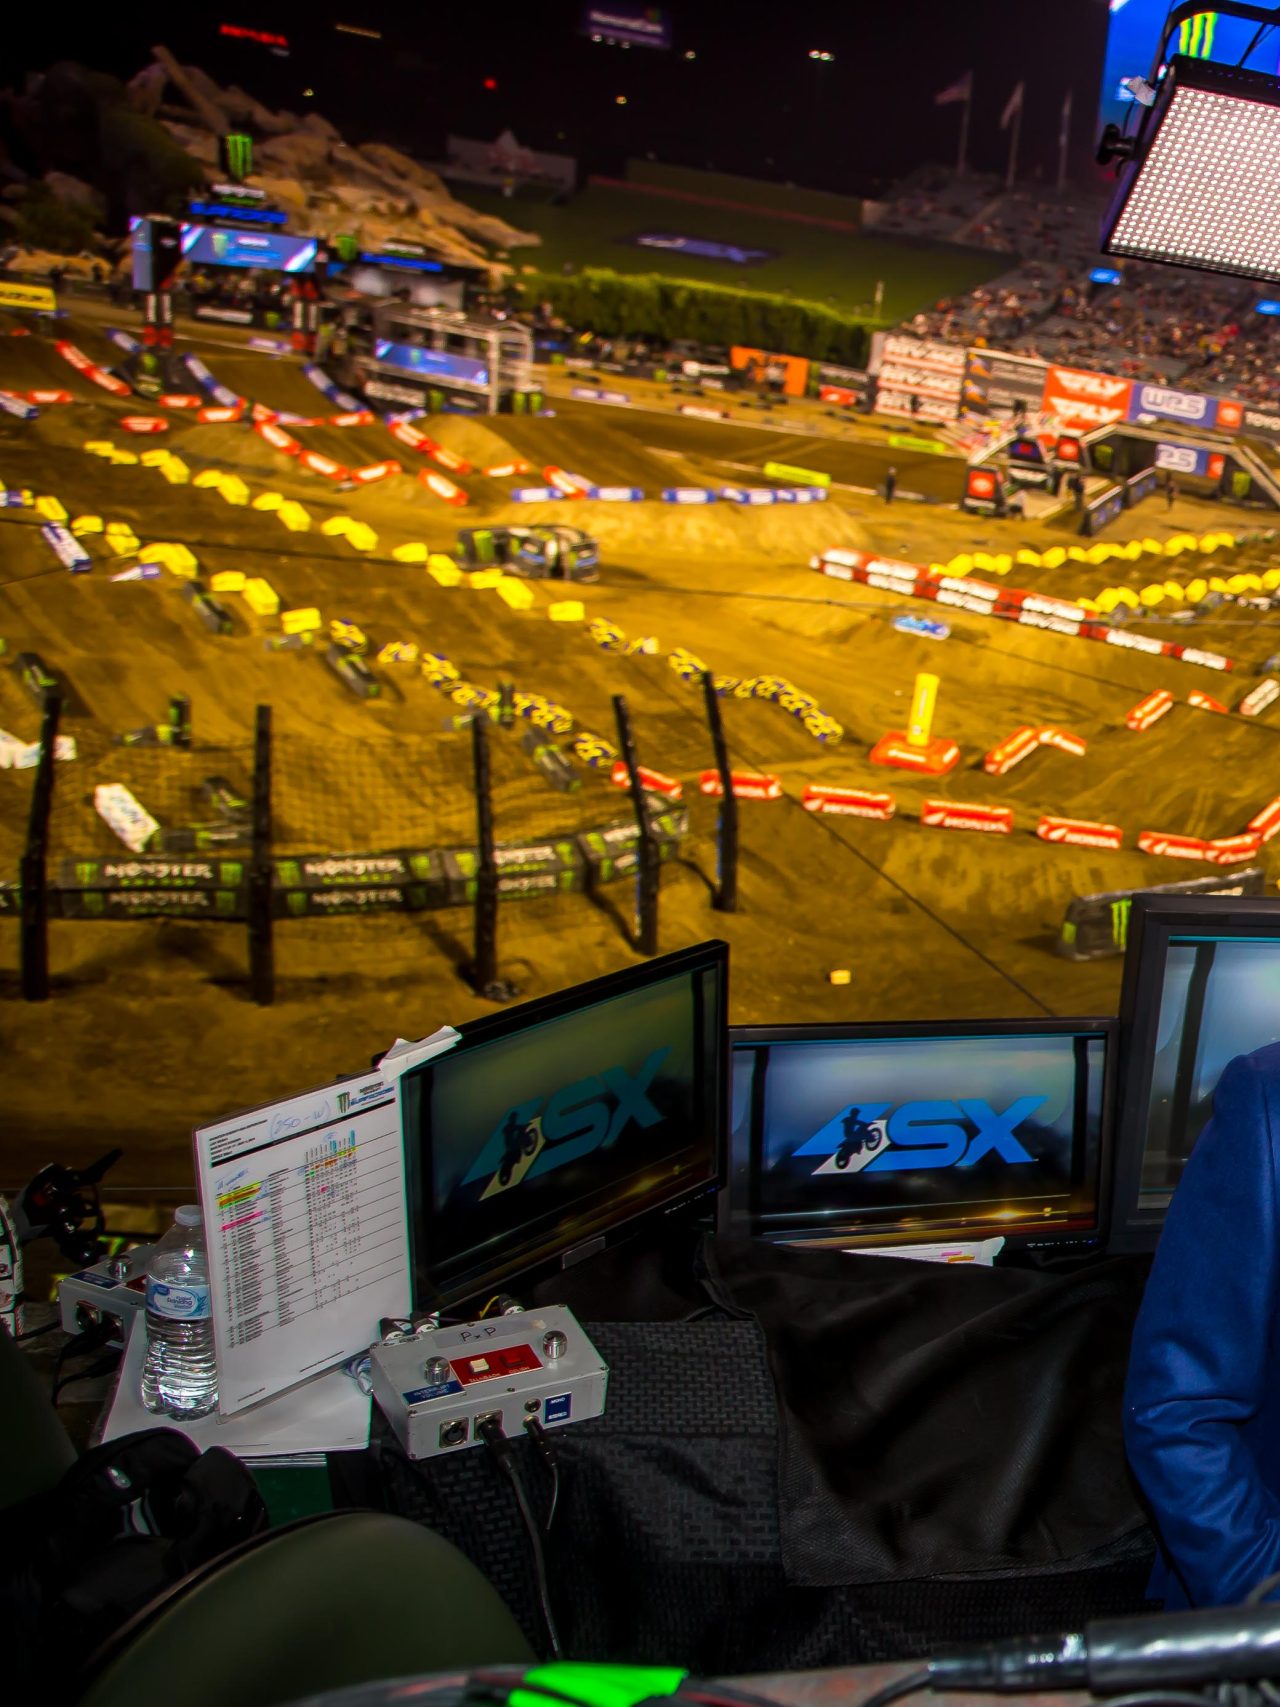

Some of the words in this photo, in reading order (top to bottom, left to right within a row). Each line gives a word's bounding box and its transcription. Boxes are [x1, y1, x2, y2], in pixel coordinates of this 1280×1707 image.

[943, 816, 1010, 833] HONDA
[104, 863, 213, 880] MONSTER
[304, 858, 404, 876] MONSTER
